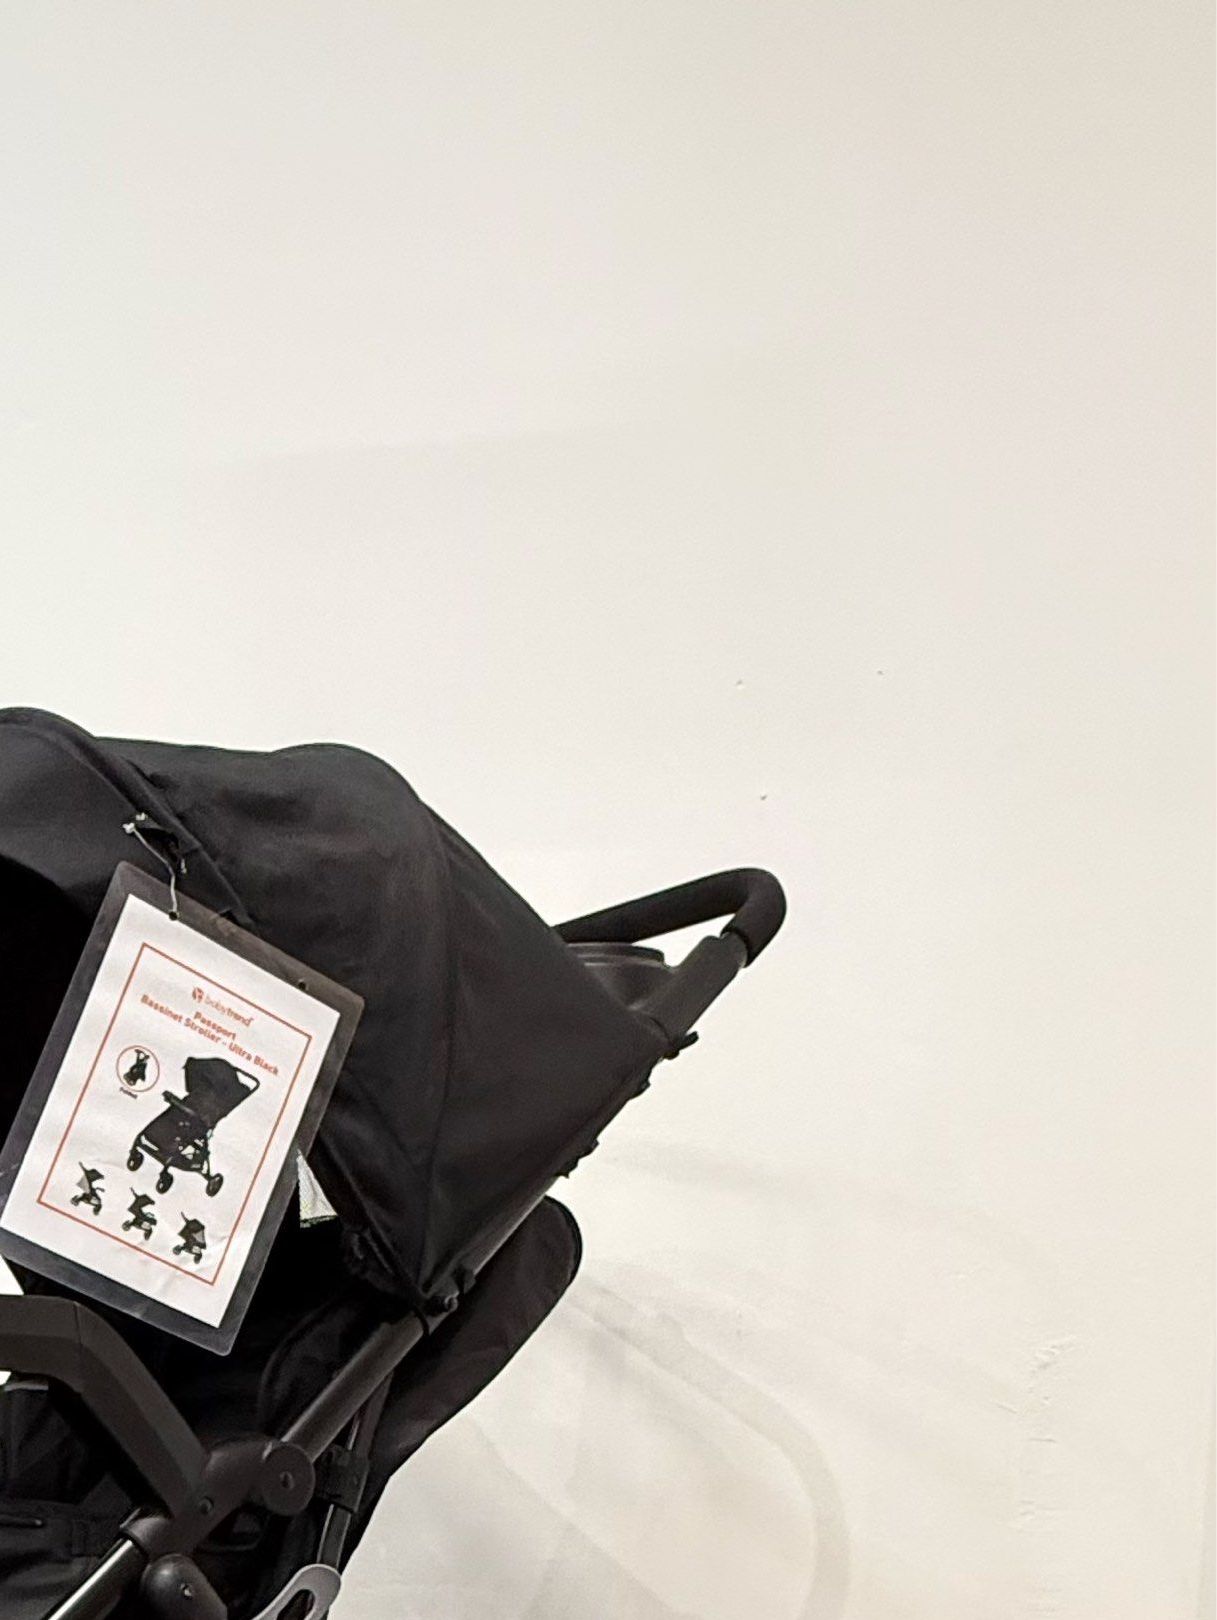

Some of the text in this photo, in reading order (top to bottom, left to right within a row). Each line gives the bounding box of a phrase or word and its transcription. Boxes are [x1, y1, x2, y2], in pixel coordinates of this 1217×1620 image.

[141, 994, 183, 1023] Bassinet
[184, 1017, 221, 1044] Stroller
[229, 1042, 252, 1061] Ultra
[254, 1055, 278, 1076] Black
[193, 1011, 237, 1040] Passport
